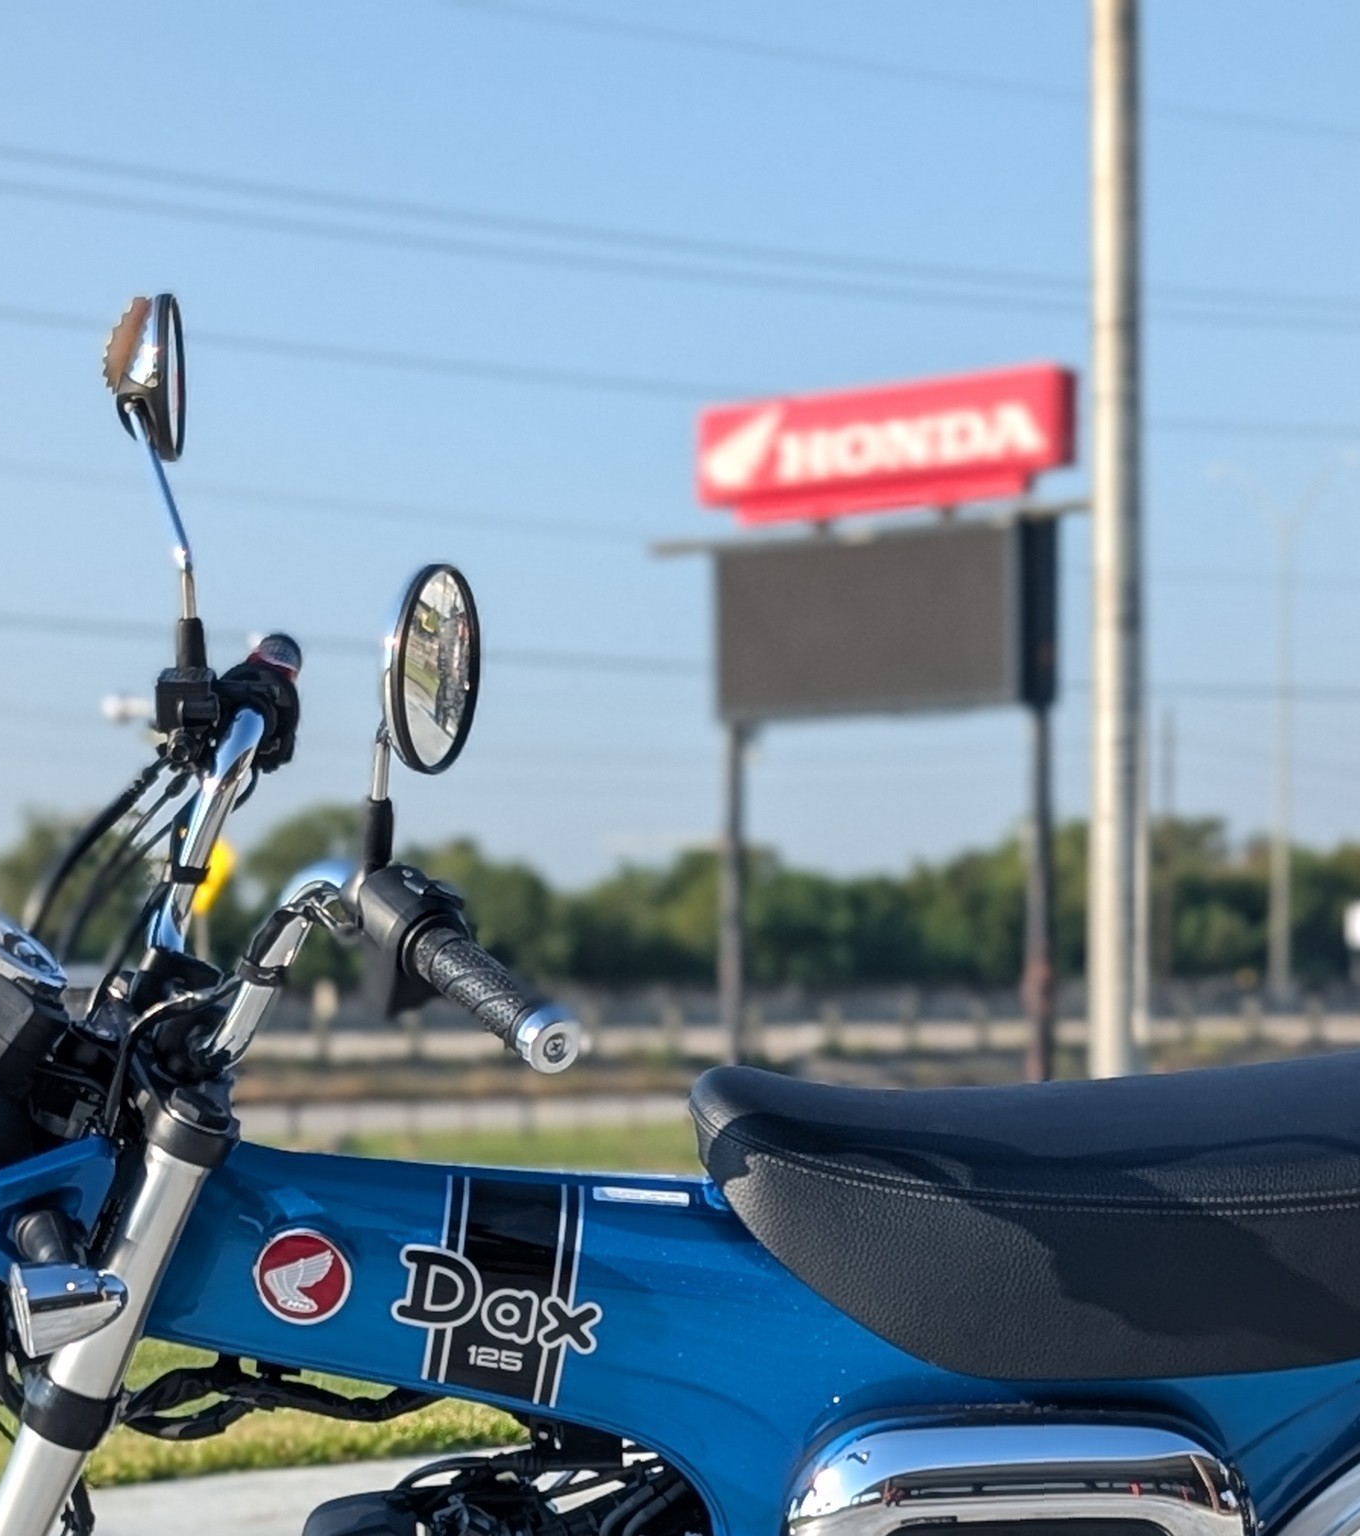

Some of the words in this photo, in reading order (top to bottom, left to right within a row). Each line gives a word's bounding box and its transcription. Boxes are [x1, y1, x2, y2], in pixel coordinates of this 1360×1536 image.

[778, 402, 1045, 479] HONDA
[391, 1244, 602, 1354] Dax
[467, 1345, 523, 1372] 125
